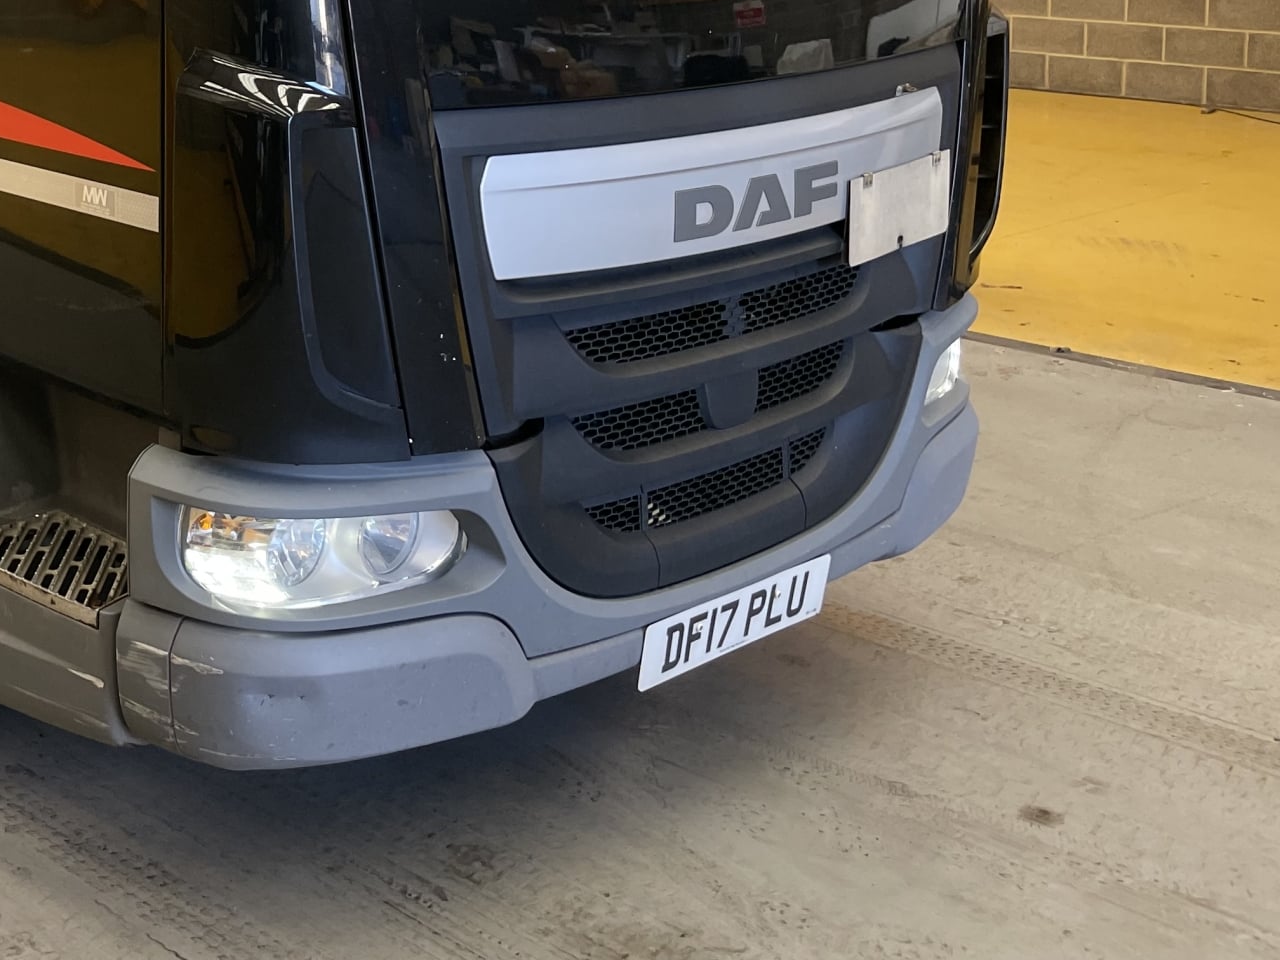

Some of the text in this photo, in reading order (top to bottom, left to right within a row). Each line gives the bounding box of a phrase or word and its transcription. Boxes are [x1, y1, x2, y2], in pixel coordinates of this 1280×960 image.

[82, 184, 108, 207] MW
[673, 160, 838, 242] DAF
[661, 571, 810, 674] DF17 PLU
